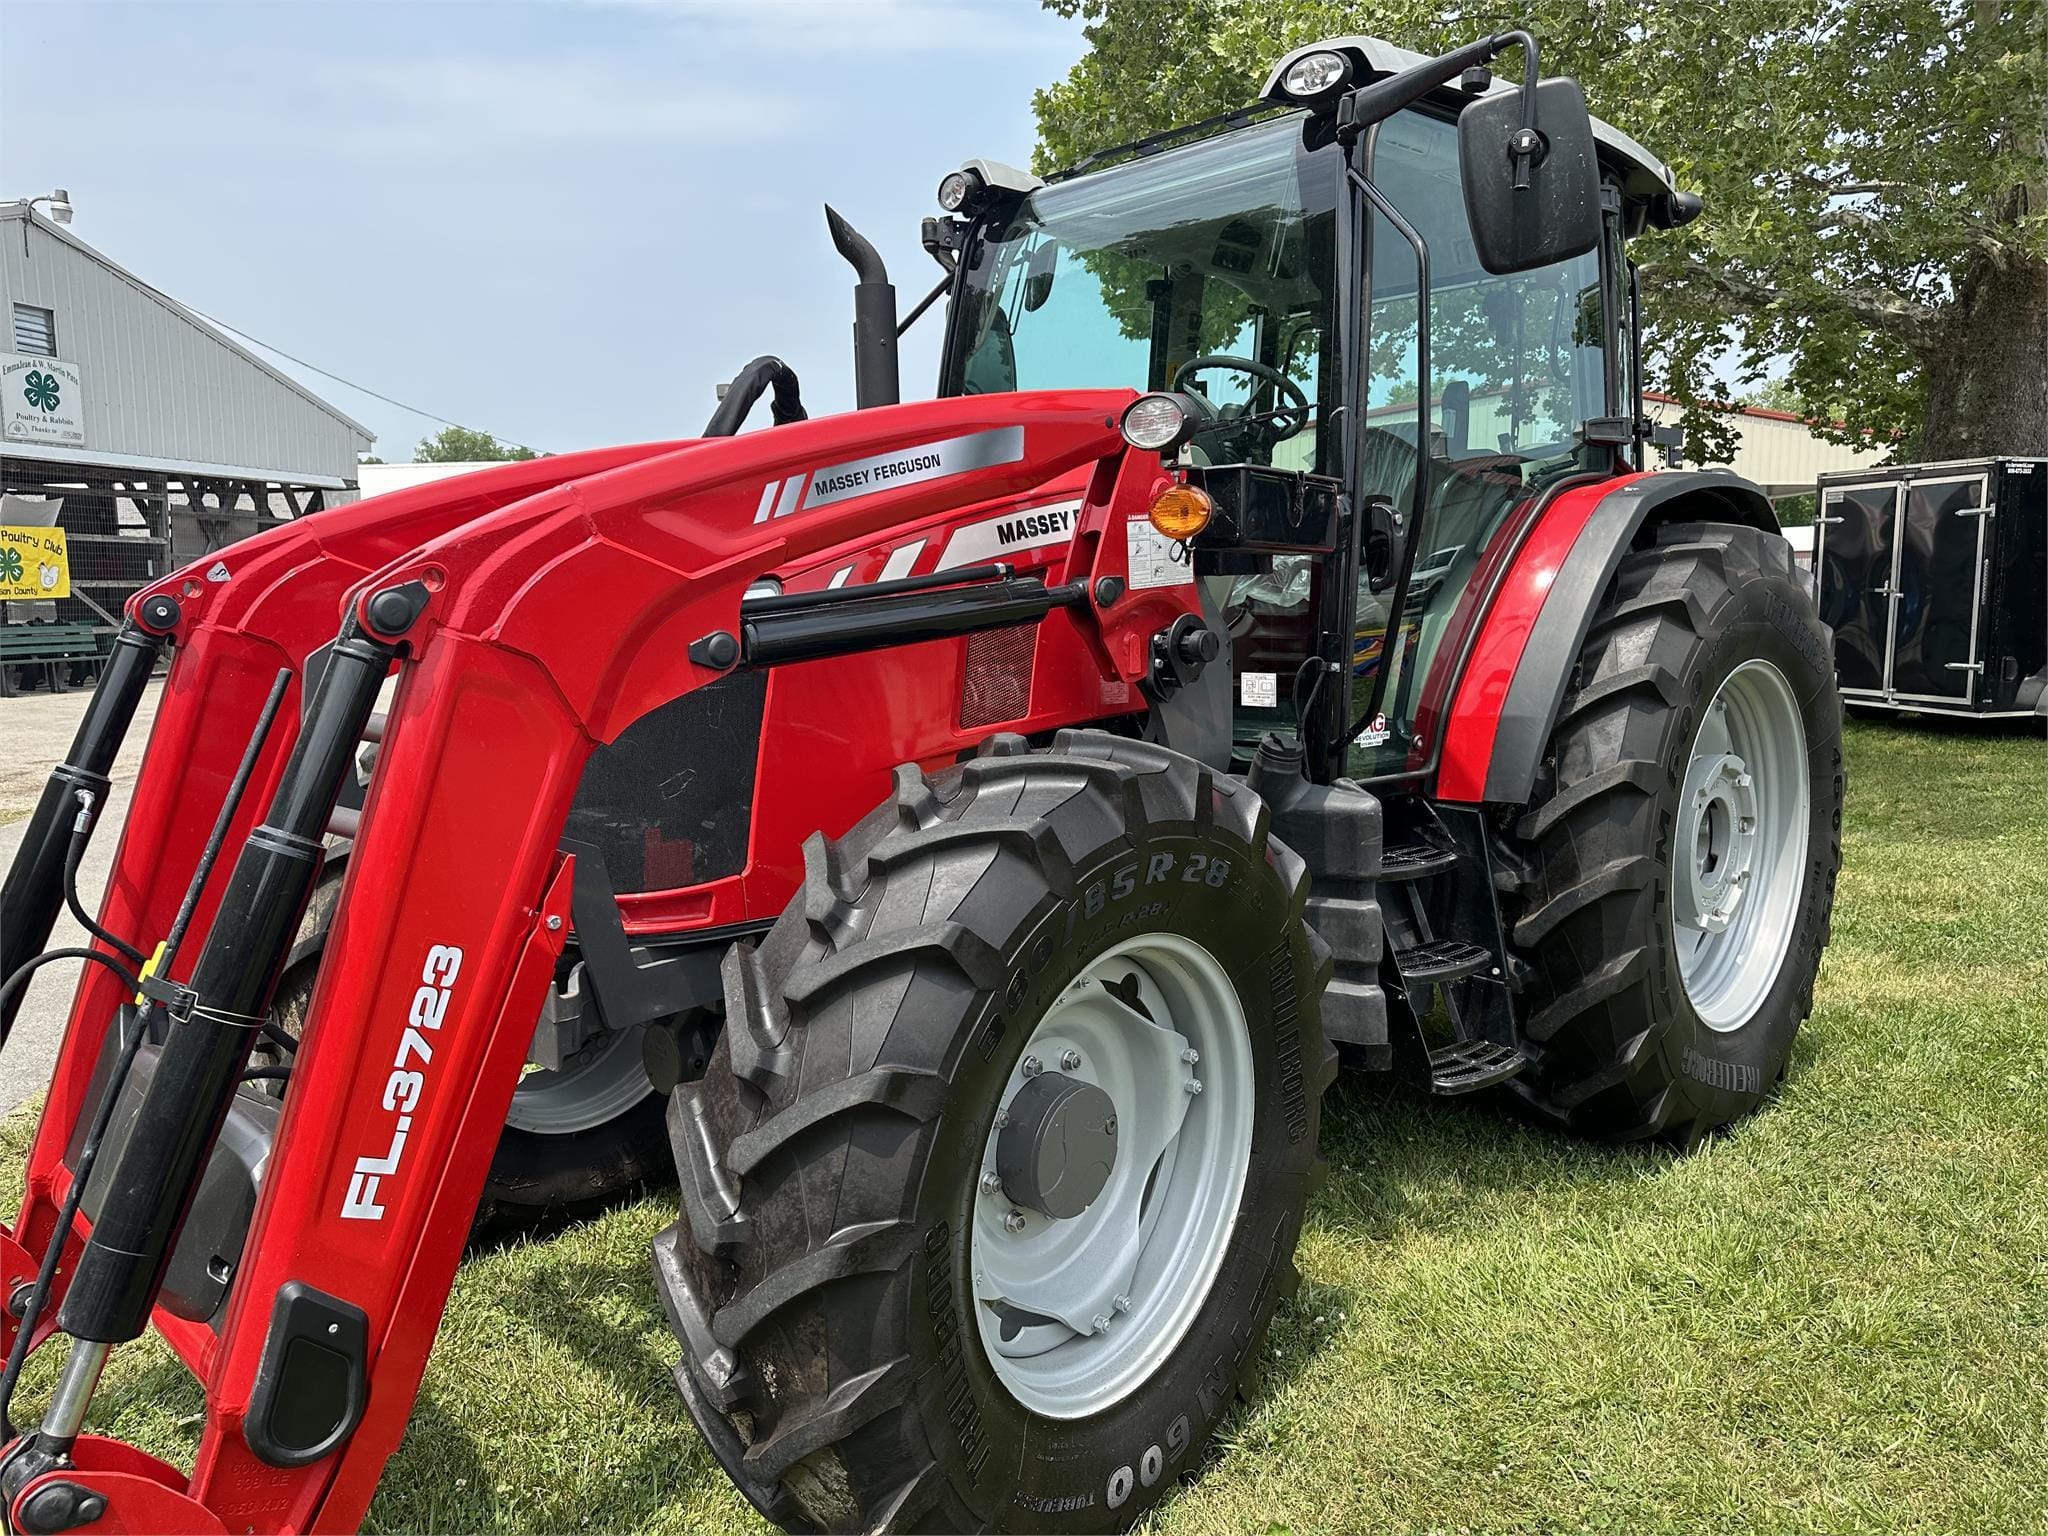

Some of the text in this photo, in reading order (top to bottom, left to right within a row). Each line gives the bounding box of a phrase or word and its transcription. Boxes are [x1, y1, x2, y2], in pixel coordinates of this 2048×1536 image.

[32, 360, 38, 368] &
[16, 412, 40, 424] Poultry
[42, 415, 48, 423] &
[814, 453, 942, 496] MASSEY FERGUSON
[1, 530, 64, 556] Poultry Club
[996, 511, 1071, 546] MASSEY
[14, 586, 38, 596] County
[1180, 852, 1232, 889] 28
[1270, 938, 1309, 1145] TRELLEBORG
[340, 944, 464, 1220] FL.3723
[1682, 1047, 1761, 1095] TRELLEBORG
